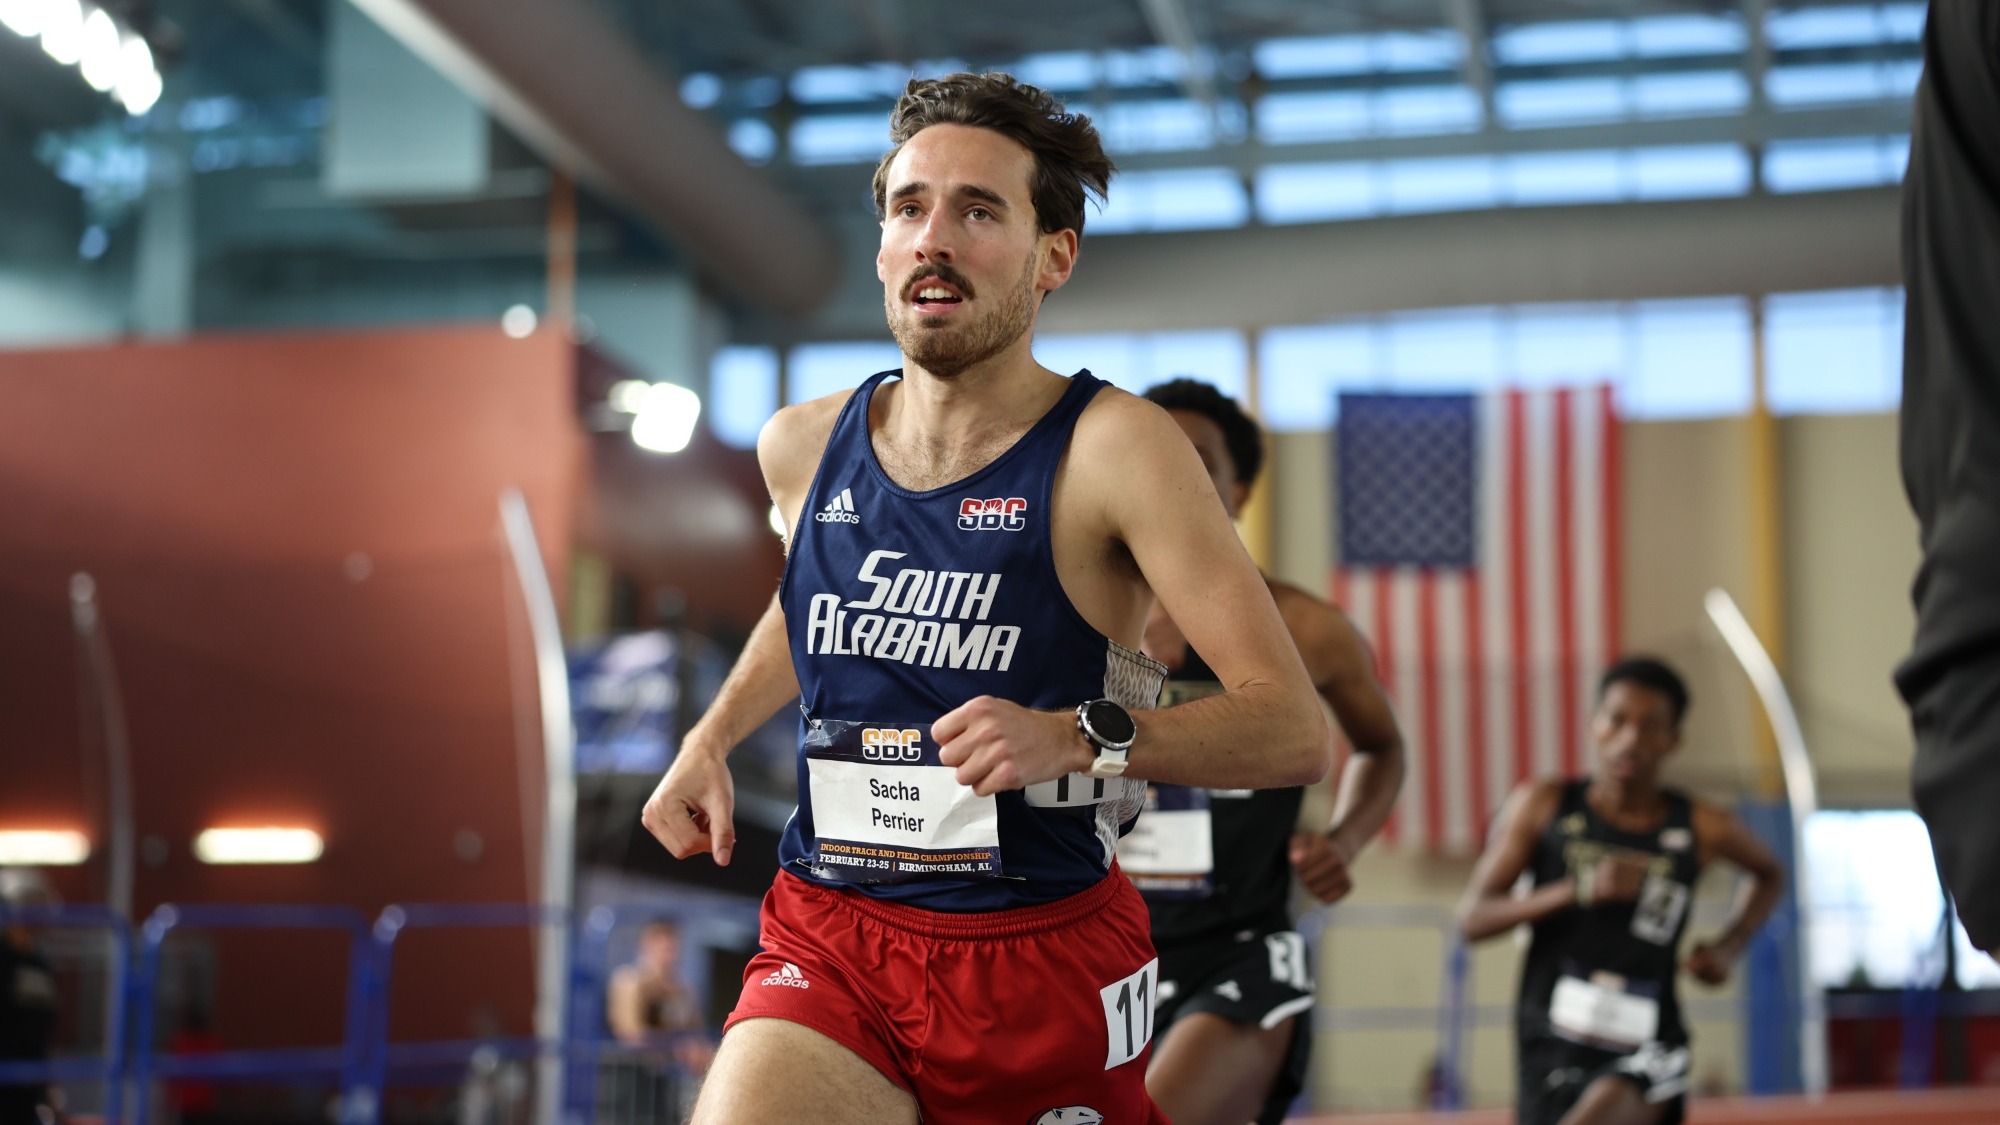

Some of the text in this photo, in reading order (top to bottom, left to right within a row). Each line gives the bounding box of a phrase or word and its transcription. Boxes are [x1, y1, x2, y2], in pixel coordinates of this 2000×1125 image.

[814, 509, 861, 525] adidas
[958, 498, 1028, 532] SBC
[862, 727, 922, 761] SBC
[869, 777, 921, 802] Sacha
[871, 806, 926, 834] Perrier
[819, 853, 993, 873] FEBRUARY 23-25 BIRMINGHAM, AL
[820, 843, 992, 862] INDOOR TRACK AND FIELD CHAMPIONSHIP
[761, 975, 810, 989] adidas
[1116, 970, 1148, 1058] 11
